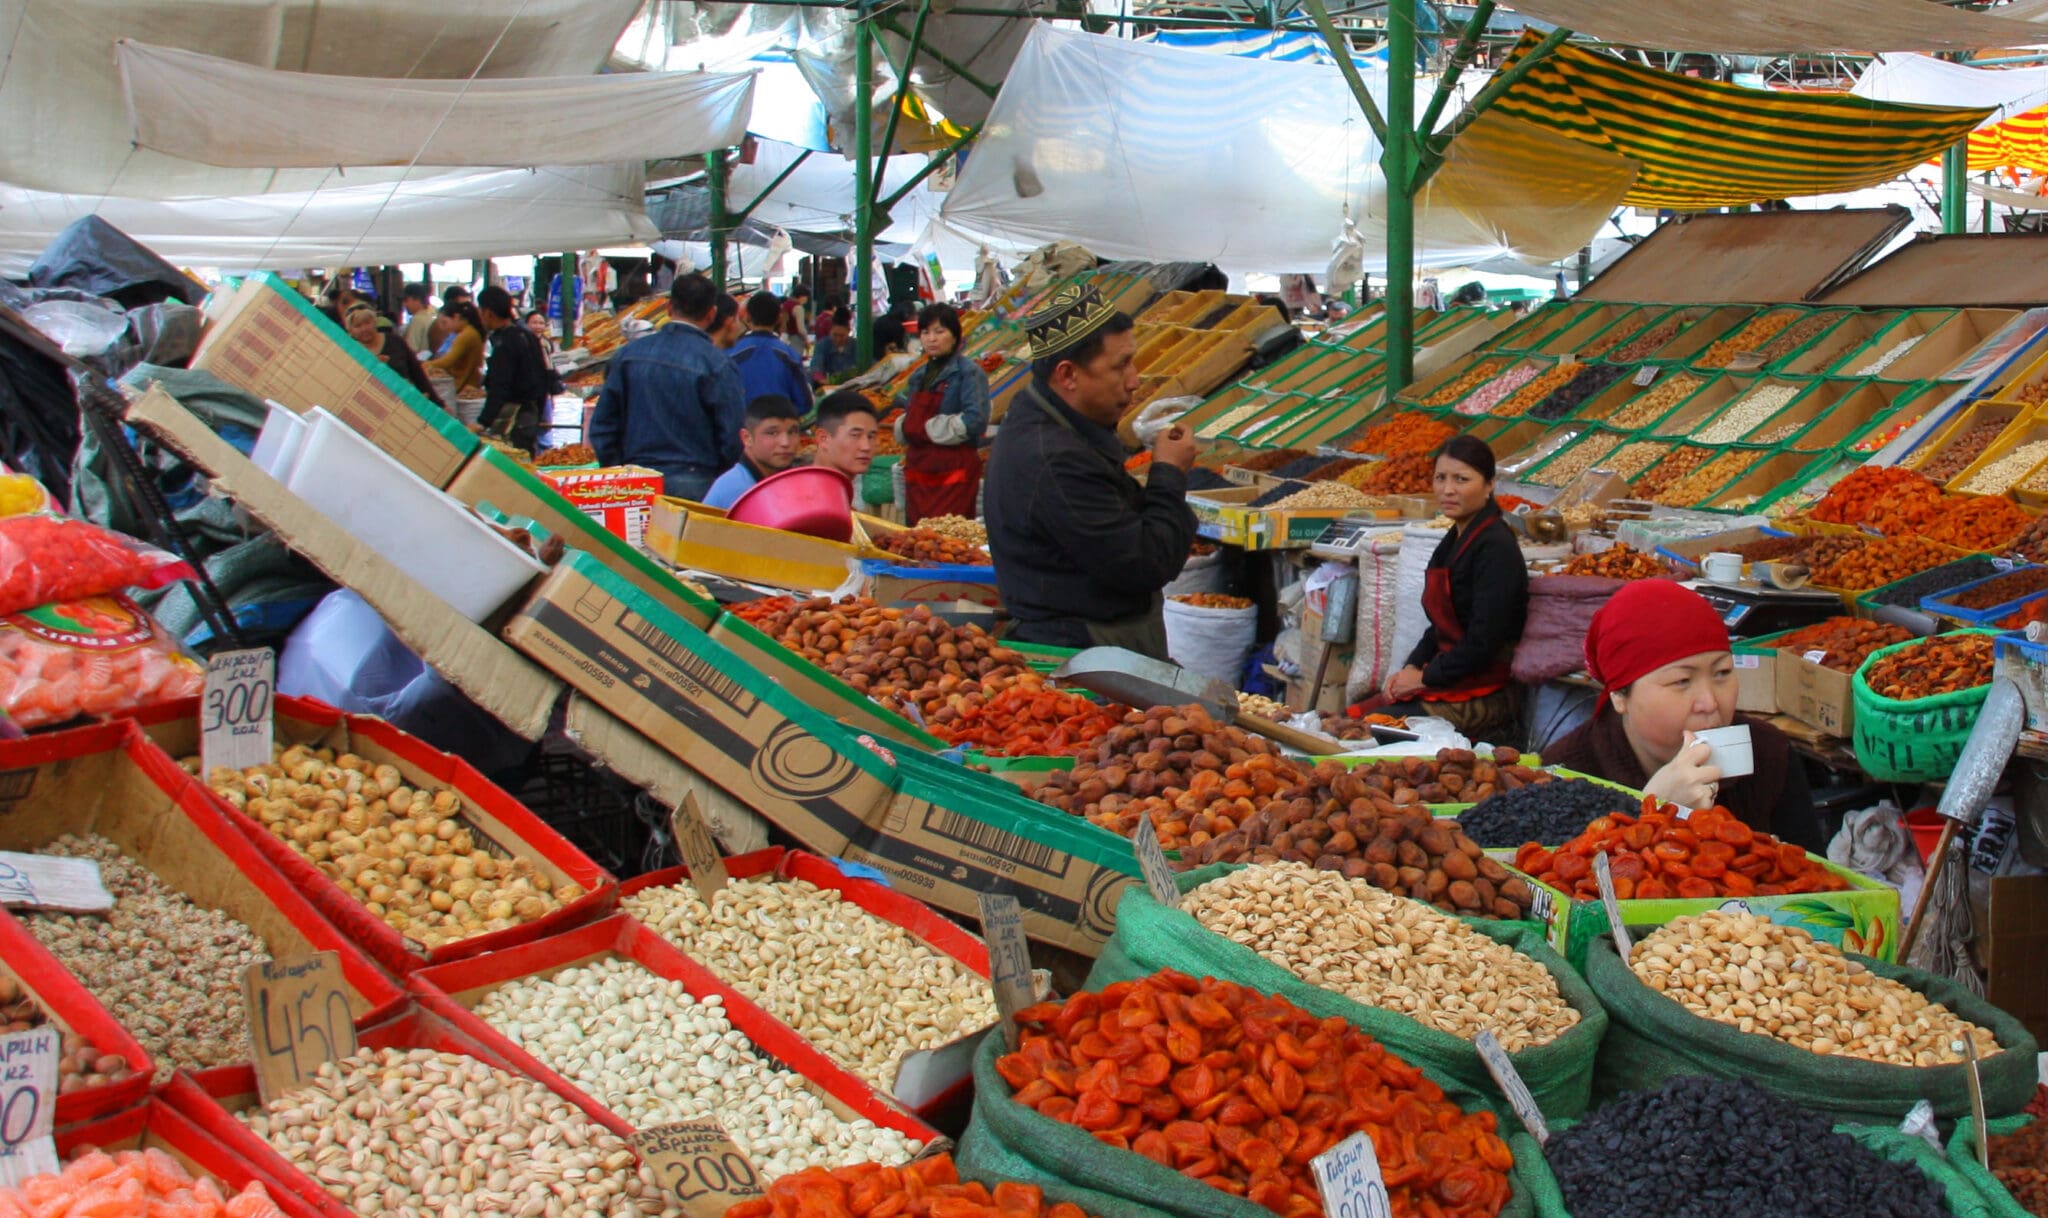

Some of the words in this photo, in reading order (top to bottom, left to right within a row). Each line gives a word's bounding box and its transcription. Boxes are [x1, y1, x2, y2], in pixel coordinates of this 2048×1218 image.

[32, 626, 118, 646] FRUIT
[204, 680, 269, 732] 300
[992, 941, 1026, 982] 230
[260, 983, 356, 1082] 450
[0, 1085, 39, 1146] 0
[665, 1152, 756, 1200] 200
[1326, 1142, 1363, 1183] Гибрит
